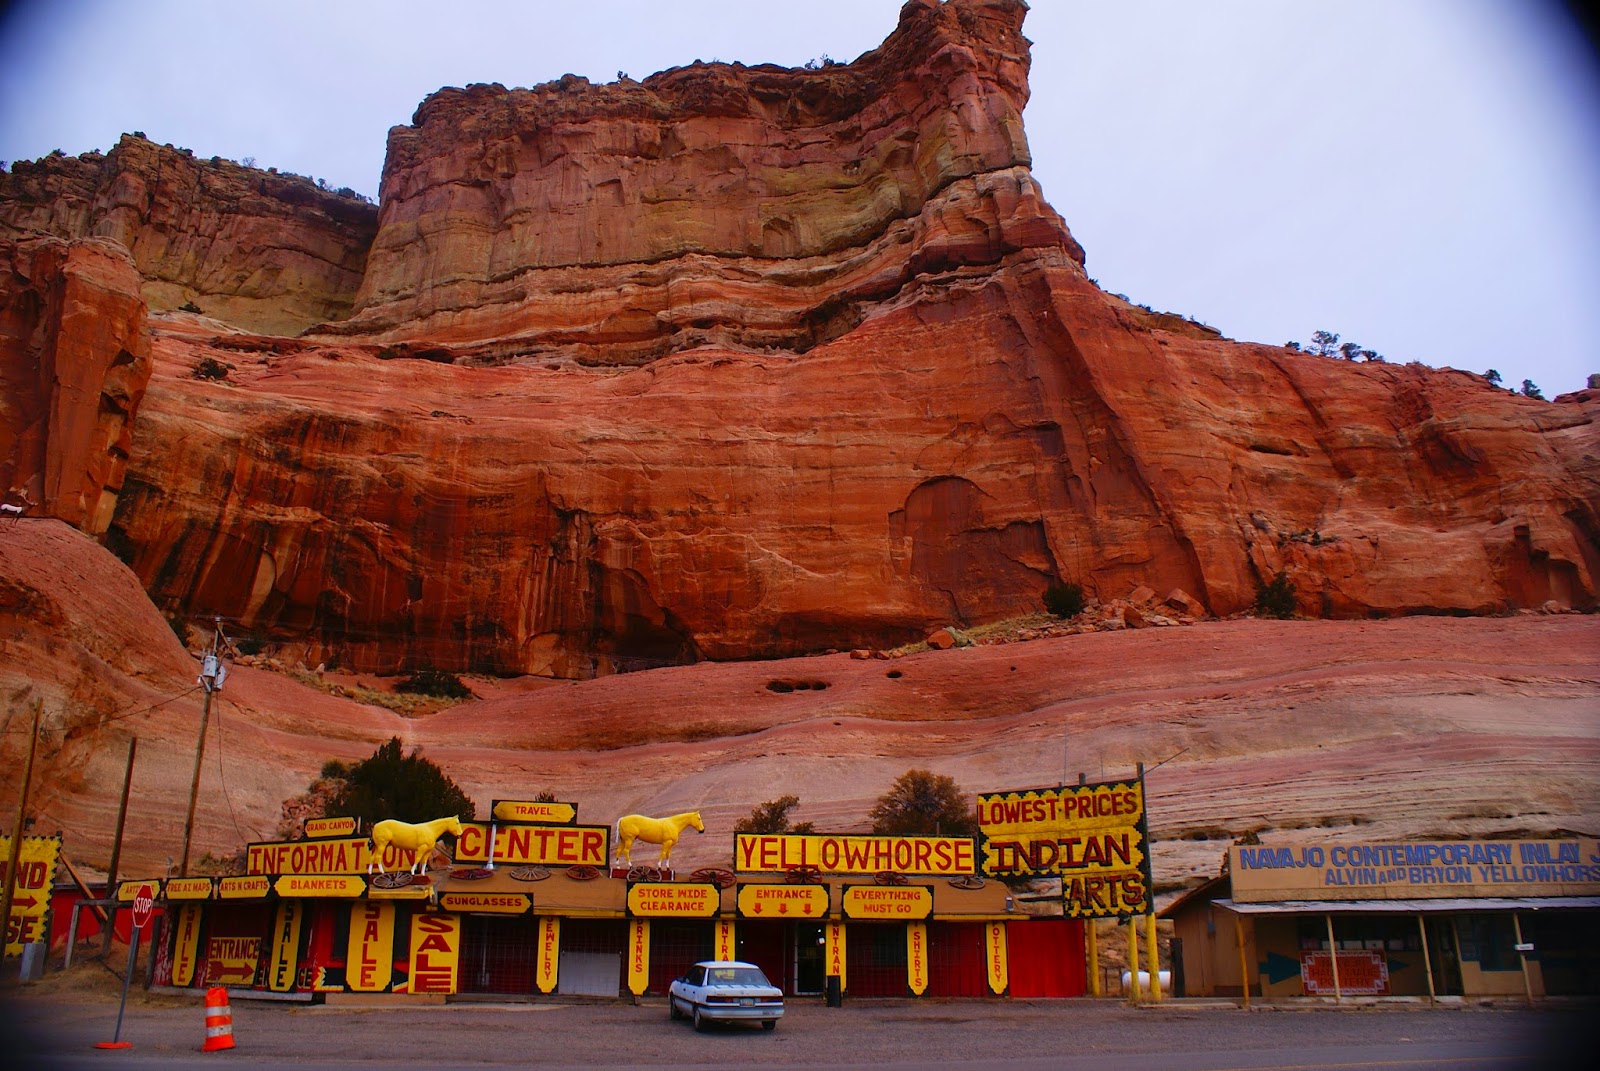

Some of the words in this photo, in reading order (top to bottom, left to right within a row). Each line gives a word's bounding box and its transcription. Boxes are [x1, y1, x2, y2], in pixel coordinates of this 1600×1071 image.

[515, 806, 551, 815] TRAVEL
[979, 798, 1060, 826] LOWEST
[1064, 792, 1138, 820] PRICES
[306, 822, 326, 831] GRAND
[329, 821, 354, 830] CANYON
[460, 827, 604, 862] CENTER
[989, 833, 1131, 872] INDIAN
[250, 841, 417, 875] INFORMATON
[740, 837, 972, 871] YELLOWHORSE
[1240, 847, 1325, 869] NAVAJO
[1331, 843, 1513, 867] CONTEMPORARY
[1519, 843, 1580, 864] INLAY
[1324, 868, 1377, 885] ALVIN
[1378, 868, 1406, 884] AND
[1409, 866, 1472, 884] BRYON
[167, 883, 182, 892] FREE
[193, 882, 210, 892] MAPS
[220, 882, 236, 891] ARTS
[244, 881, 268, 890] CRAFTS
[290, 880, 347, 890] BLANKETS
[638, 889, 674, 899] STORE
[678, 889, 708, 899] WIDE
[756, 889, 813, 899] ENTRANCE
[1069, 873, 1144, 910] ARTS
[446, 897, 522, 907] SUNGLASSES
[853, 890, 921, 901] EVERYTHING
[134, 897, 152, 914] STOP
[640, 901, 705, 911] CLEARANCE
[863, 904, 892, 913] MUST
[896, 904, 911, 913] GO
[210, 939, 260, 960] ENTRANCE
[276, 901, 295, 987] SALE
[360, 901, 381, 987] SALE
[414, 915, 454, 993] SALE
